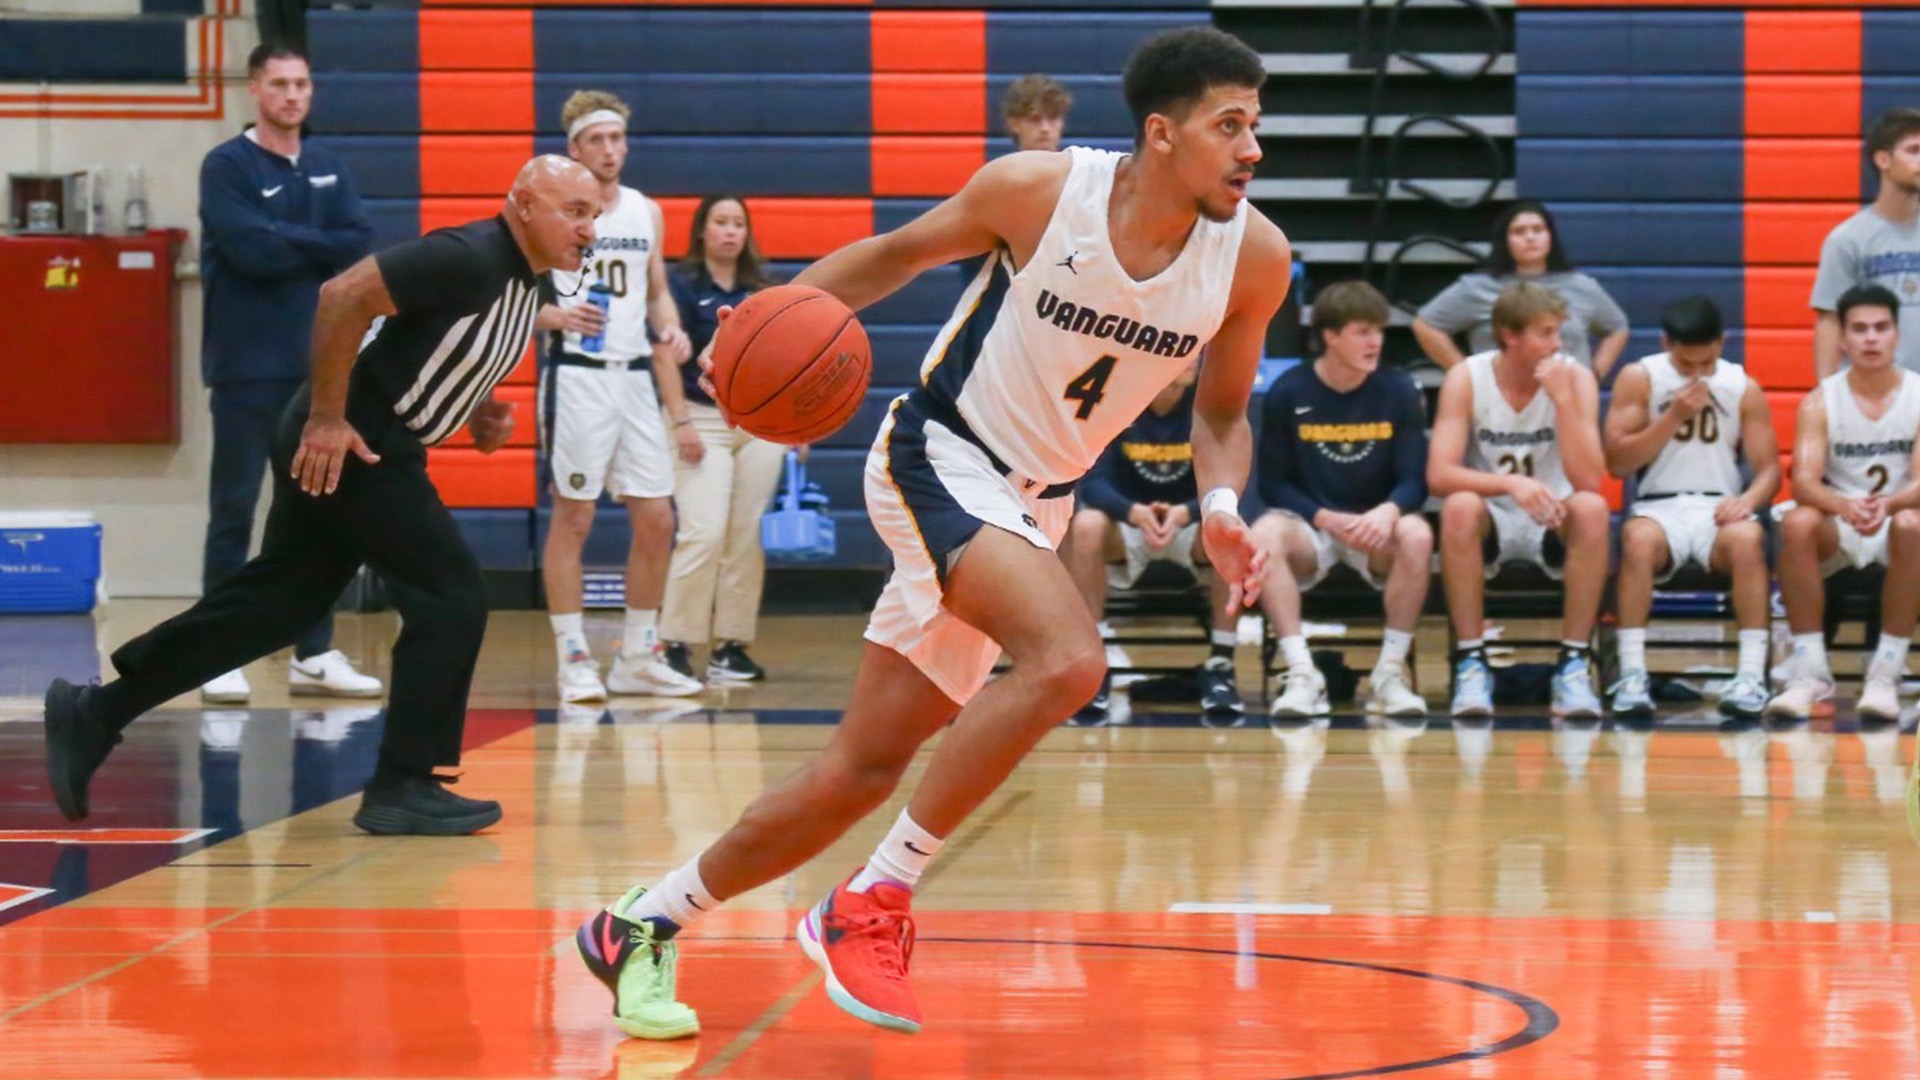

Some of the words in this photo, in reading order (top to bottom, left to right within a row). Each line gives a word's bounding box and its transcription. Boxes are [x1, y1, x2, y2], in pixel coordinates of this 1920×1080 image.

[1036, 289, 1198, 358] VANGUARD
[1063, 353, 1119, 421] 4
[1867, 464, 1888, 496] 2
